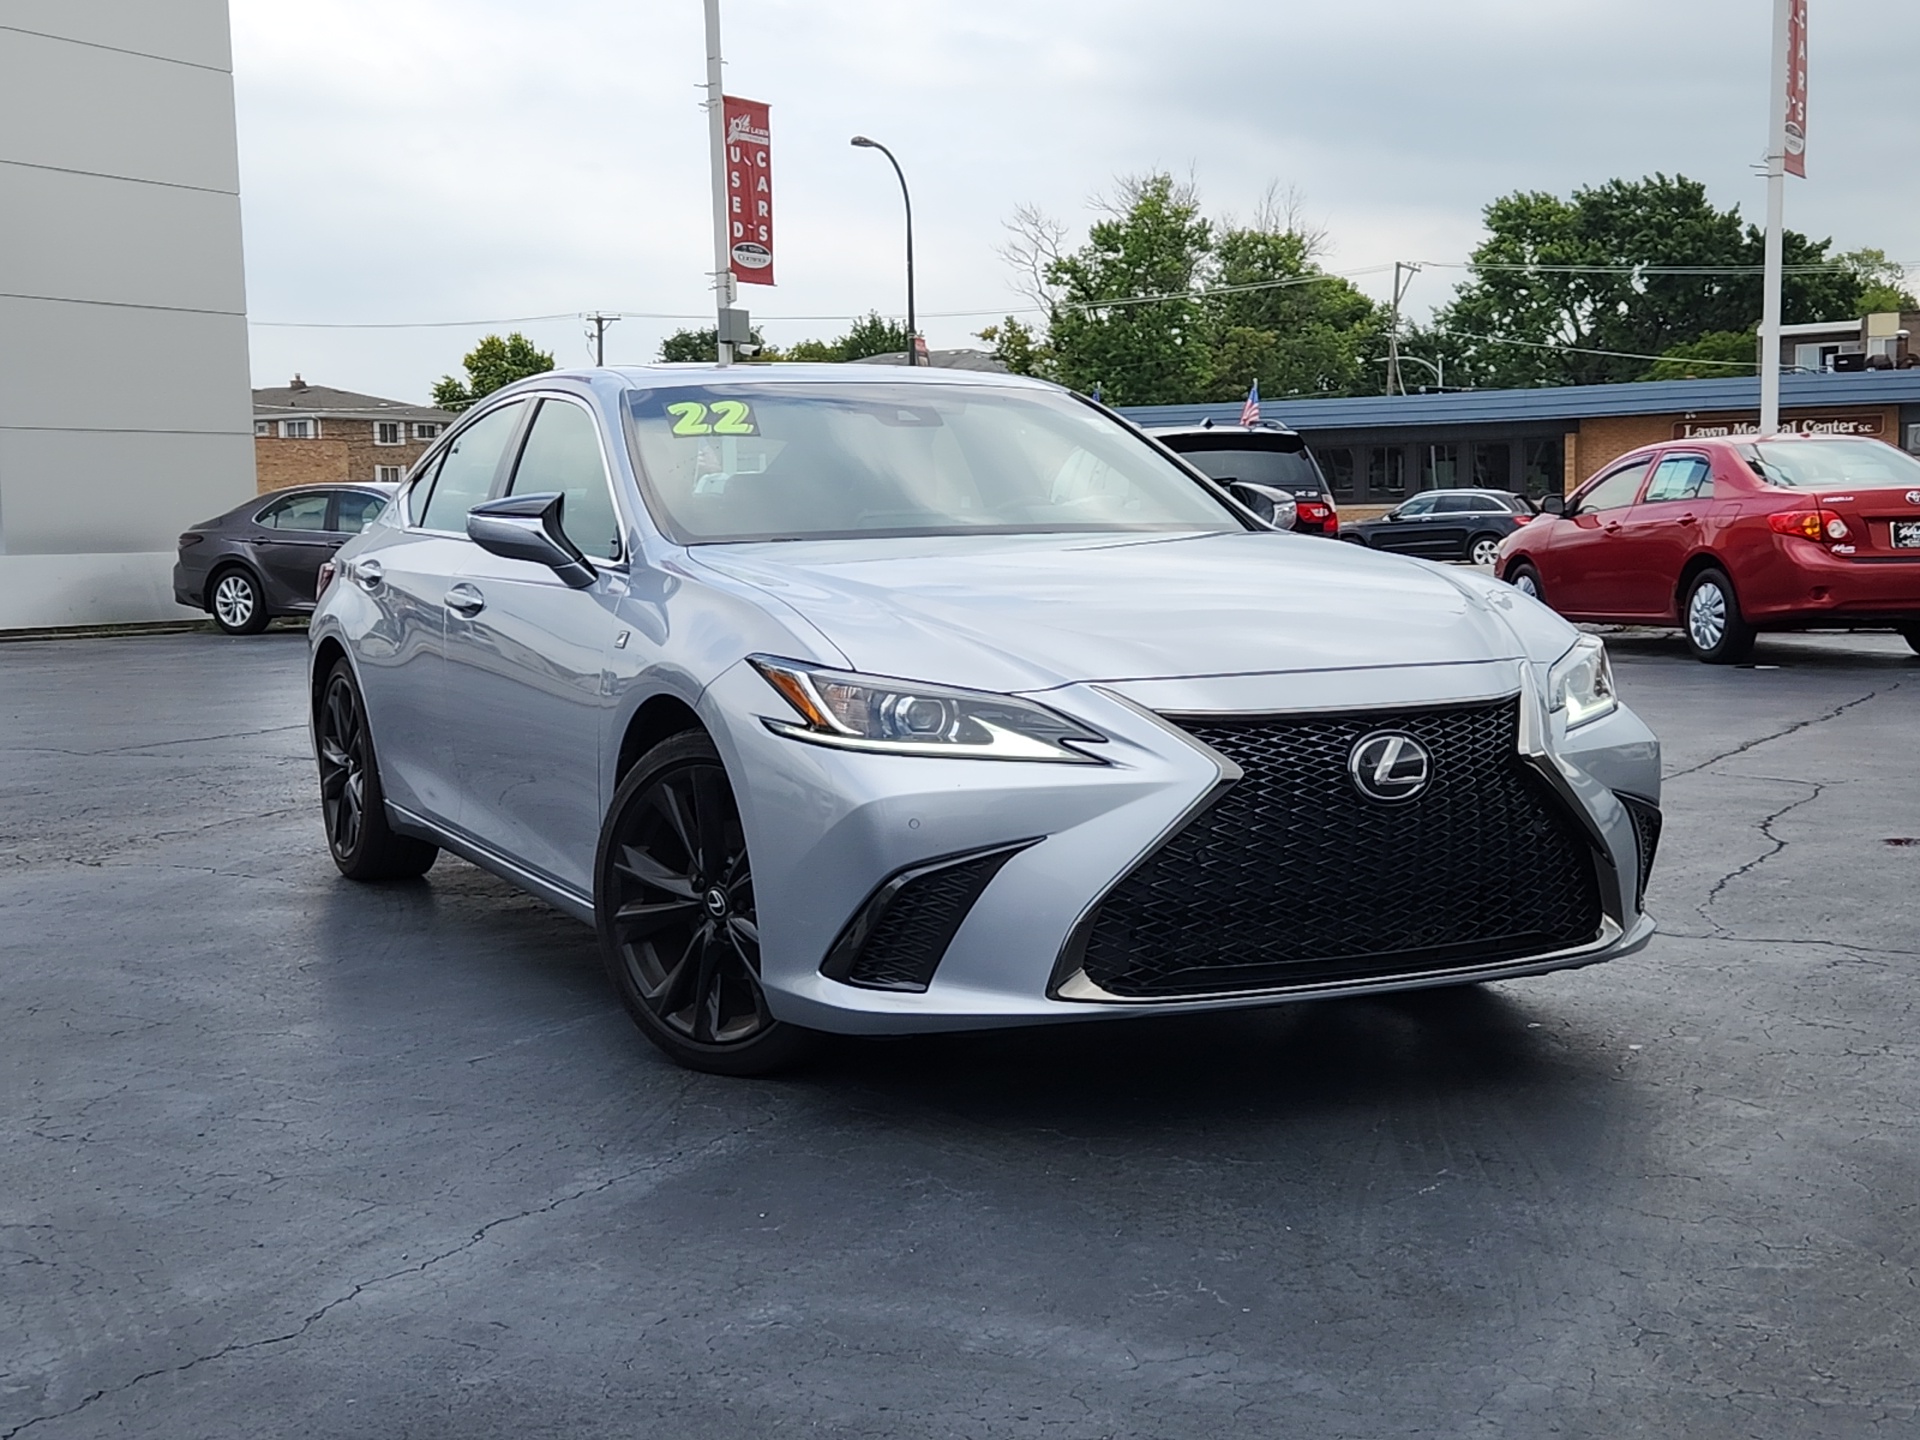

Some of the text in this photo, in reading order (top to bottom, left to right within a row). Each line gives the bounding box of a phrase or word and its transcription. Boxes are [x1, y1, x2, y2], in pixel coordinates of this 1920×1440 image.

[667, 400, 754, 435] 22
[1684, 424, 1729, 438] Lawn
[1733, 420, 1798, 435] Meal
[1802, 419, 1858, 435] Center
